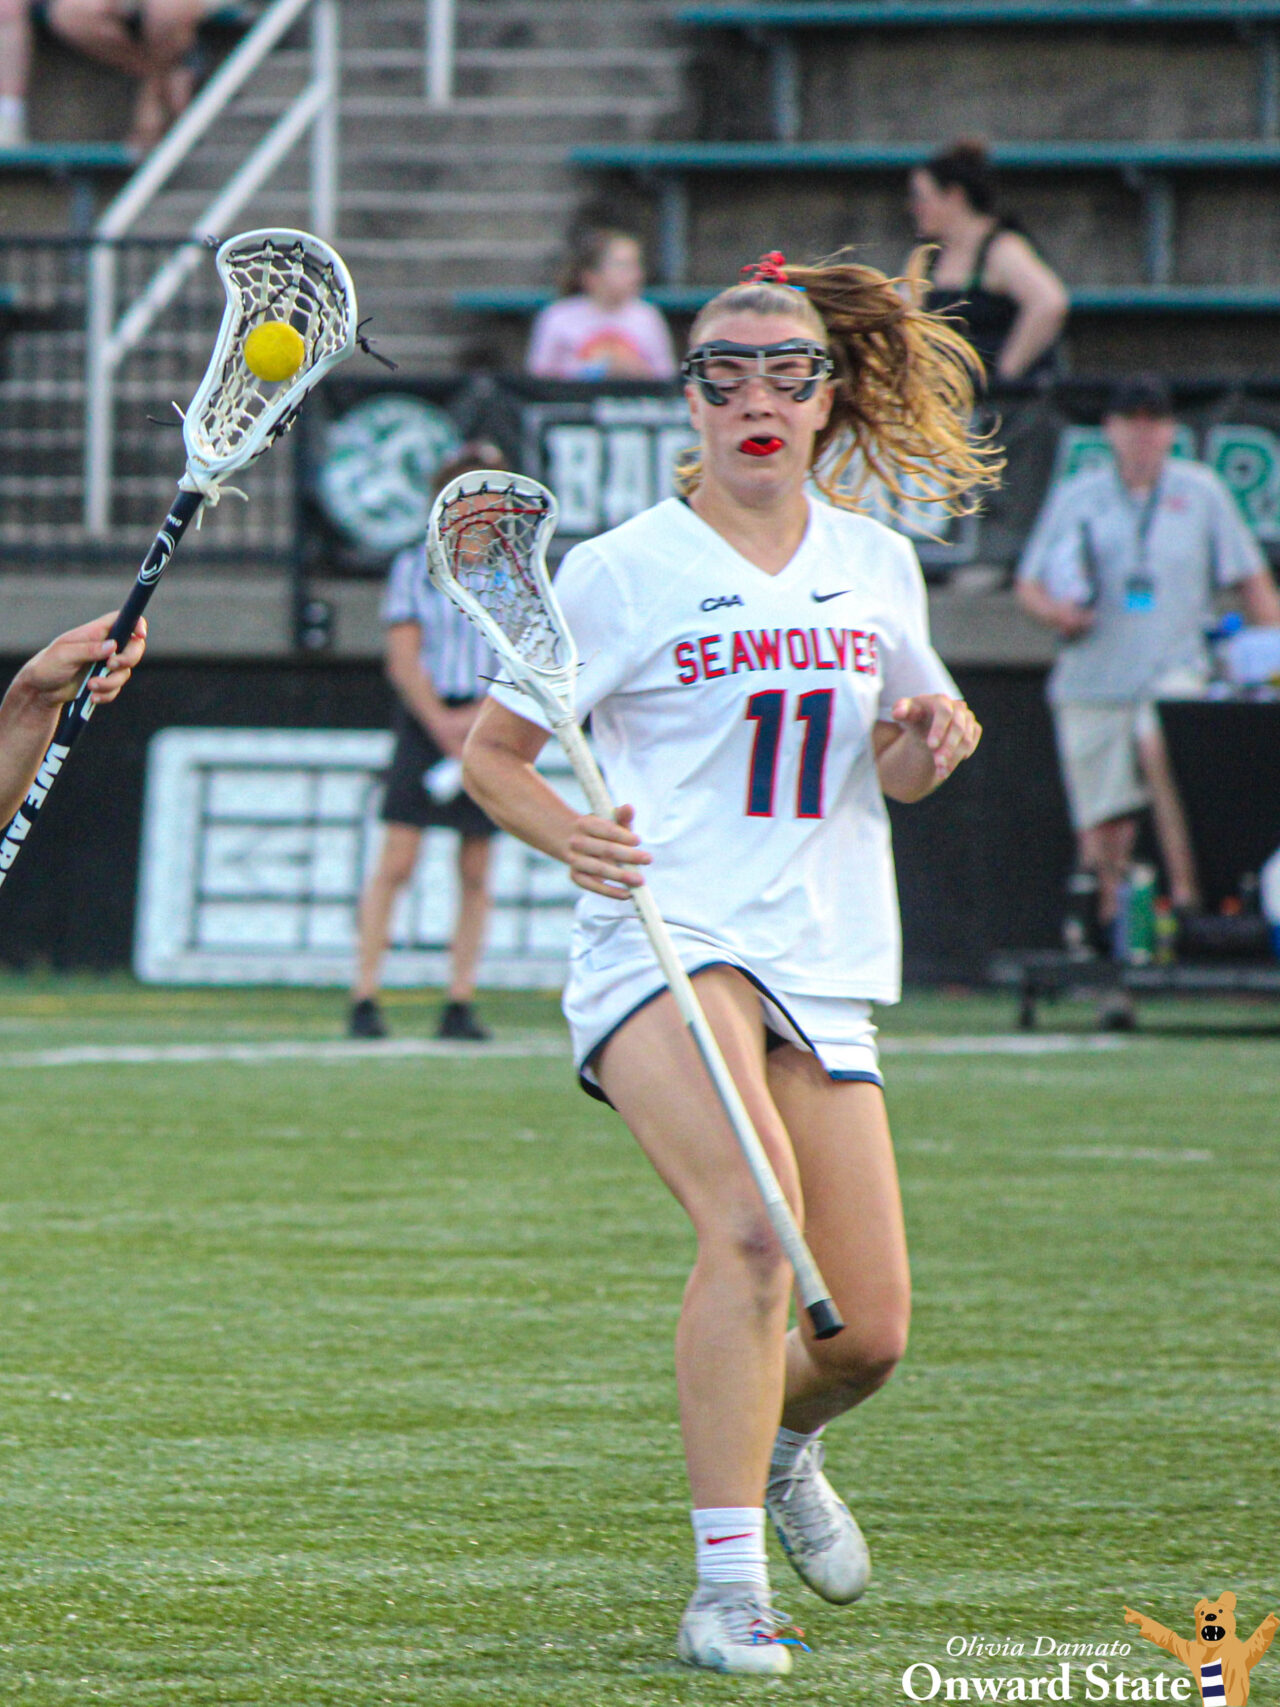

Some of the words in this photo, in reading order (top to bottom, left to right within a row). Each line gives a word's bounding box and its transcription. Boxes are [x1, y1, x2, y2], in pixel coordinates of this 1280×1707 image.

[700, 594, 745, 612] CAA
[674, 626, 878, 685] SEAWOLVES
[24, 742, 71, 810] WE
[742, 687, 836, 819] 11
